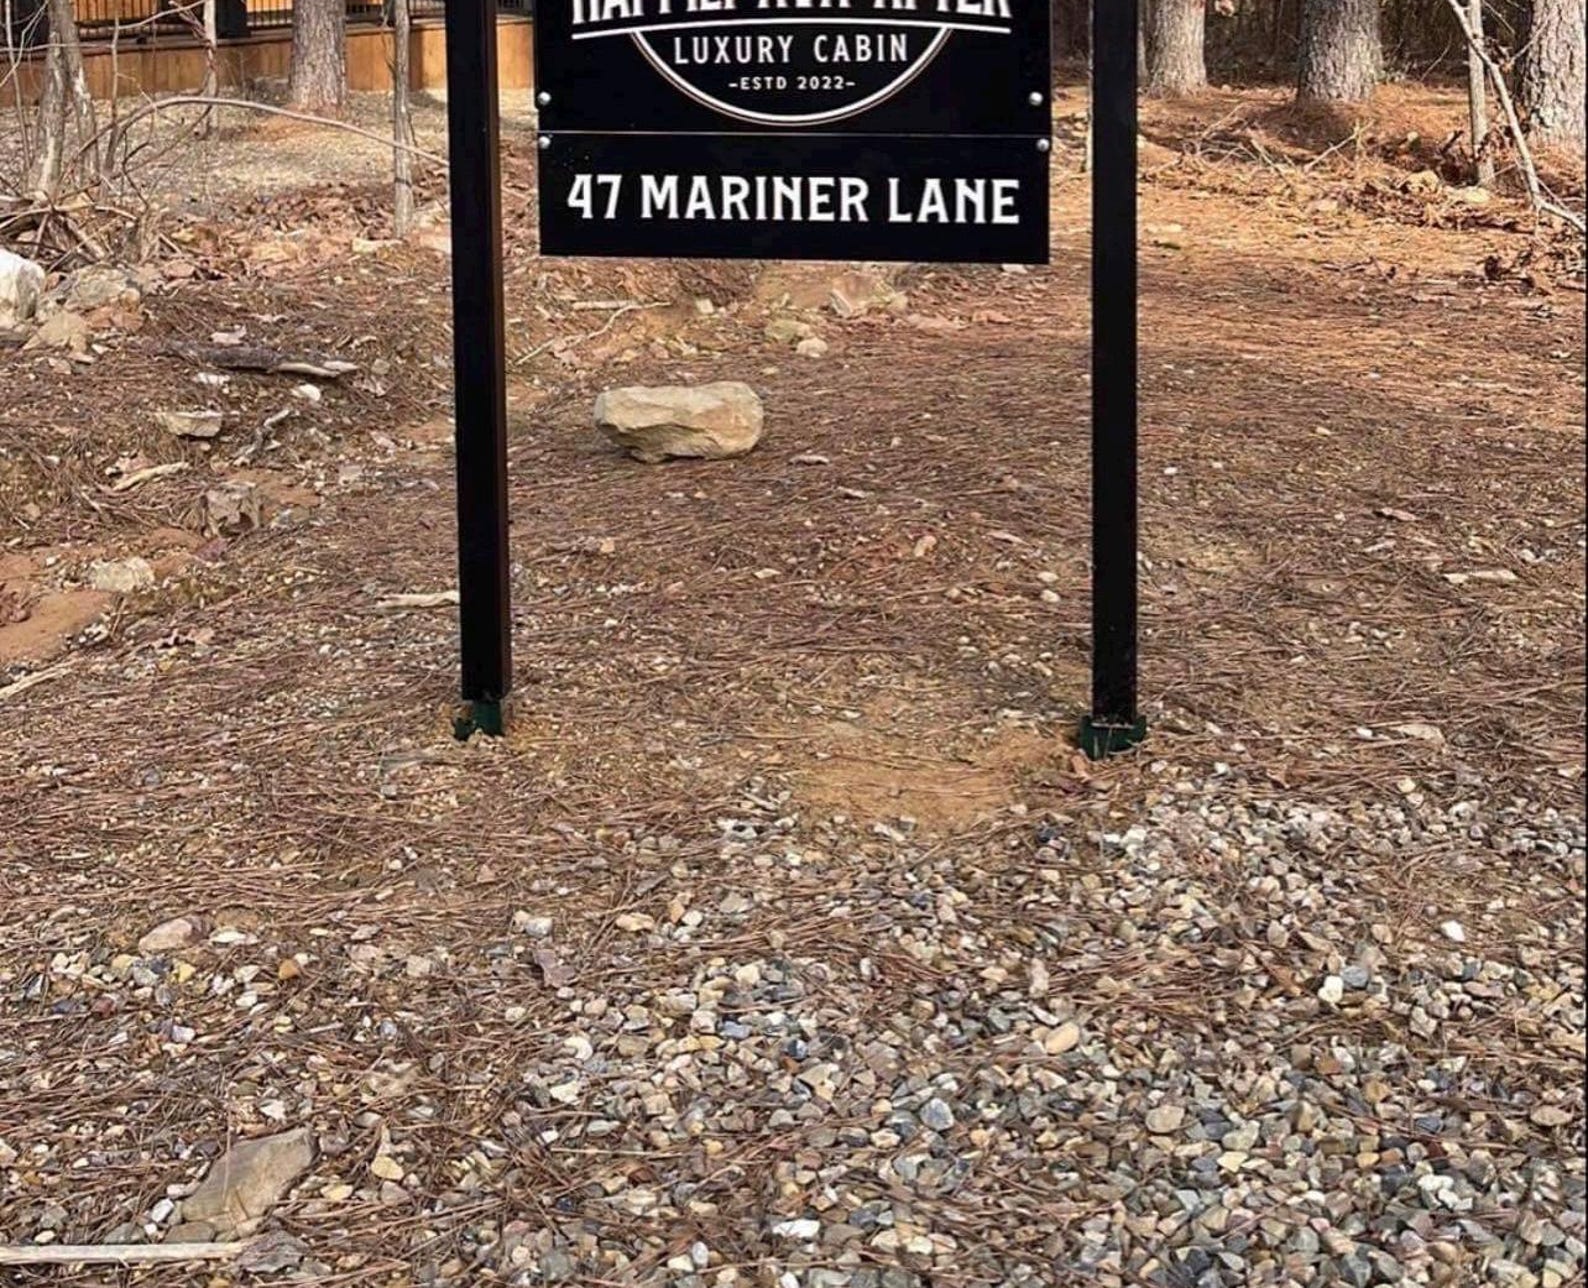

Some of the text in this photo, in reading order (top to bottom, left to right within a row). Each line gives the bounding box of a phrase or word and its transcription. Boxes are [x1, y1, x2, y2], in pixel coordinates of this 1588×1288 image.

[674, 33, 908, 65] LUXURY CABIN
[728, 75, 856, 90] -ESTD 2022-
[567, 173, 1020, 224] 47 MARINER LANE
